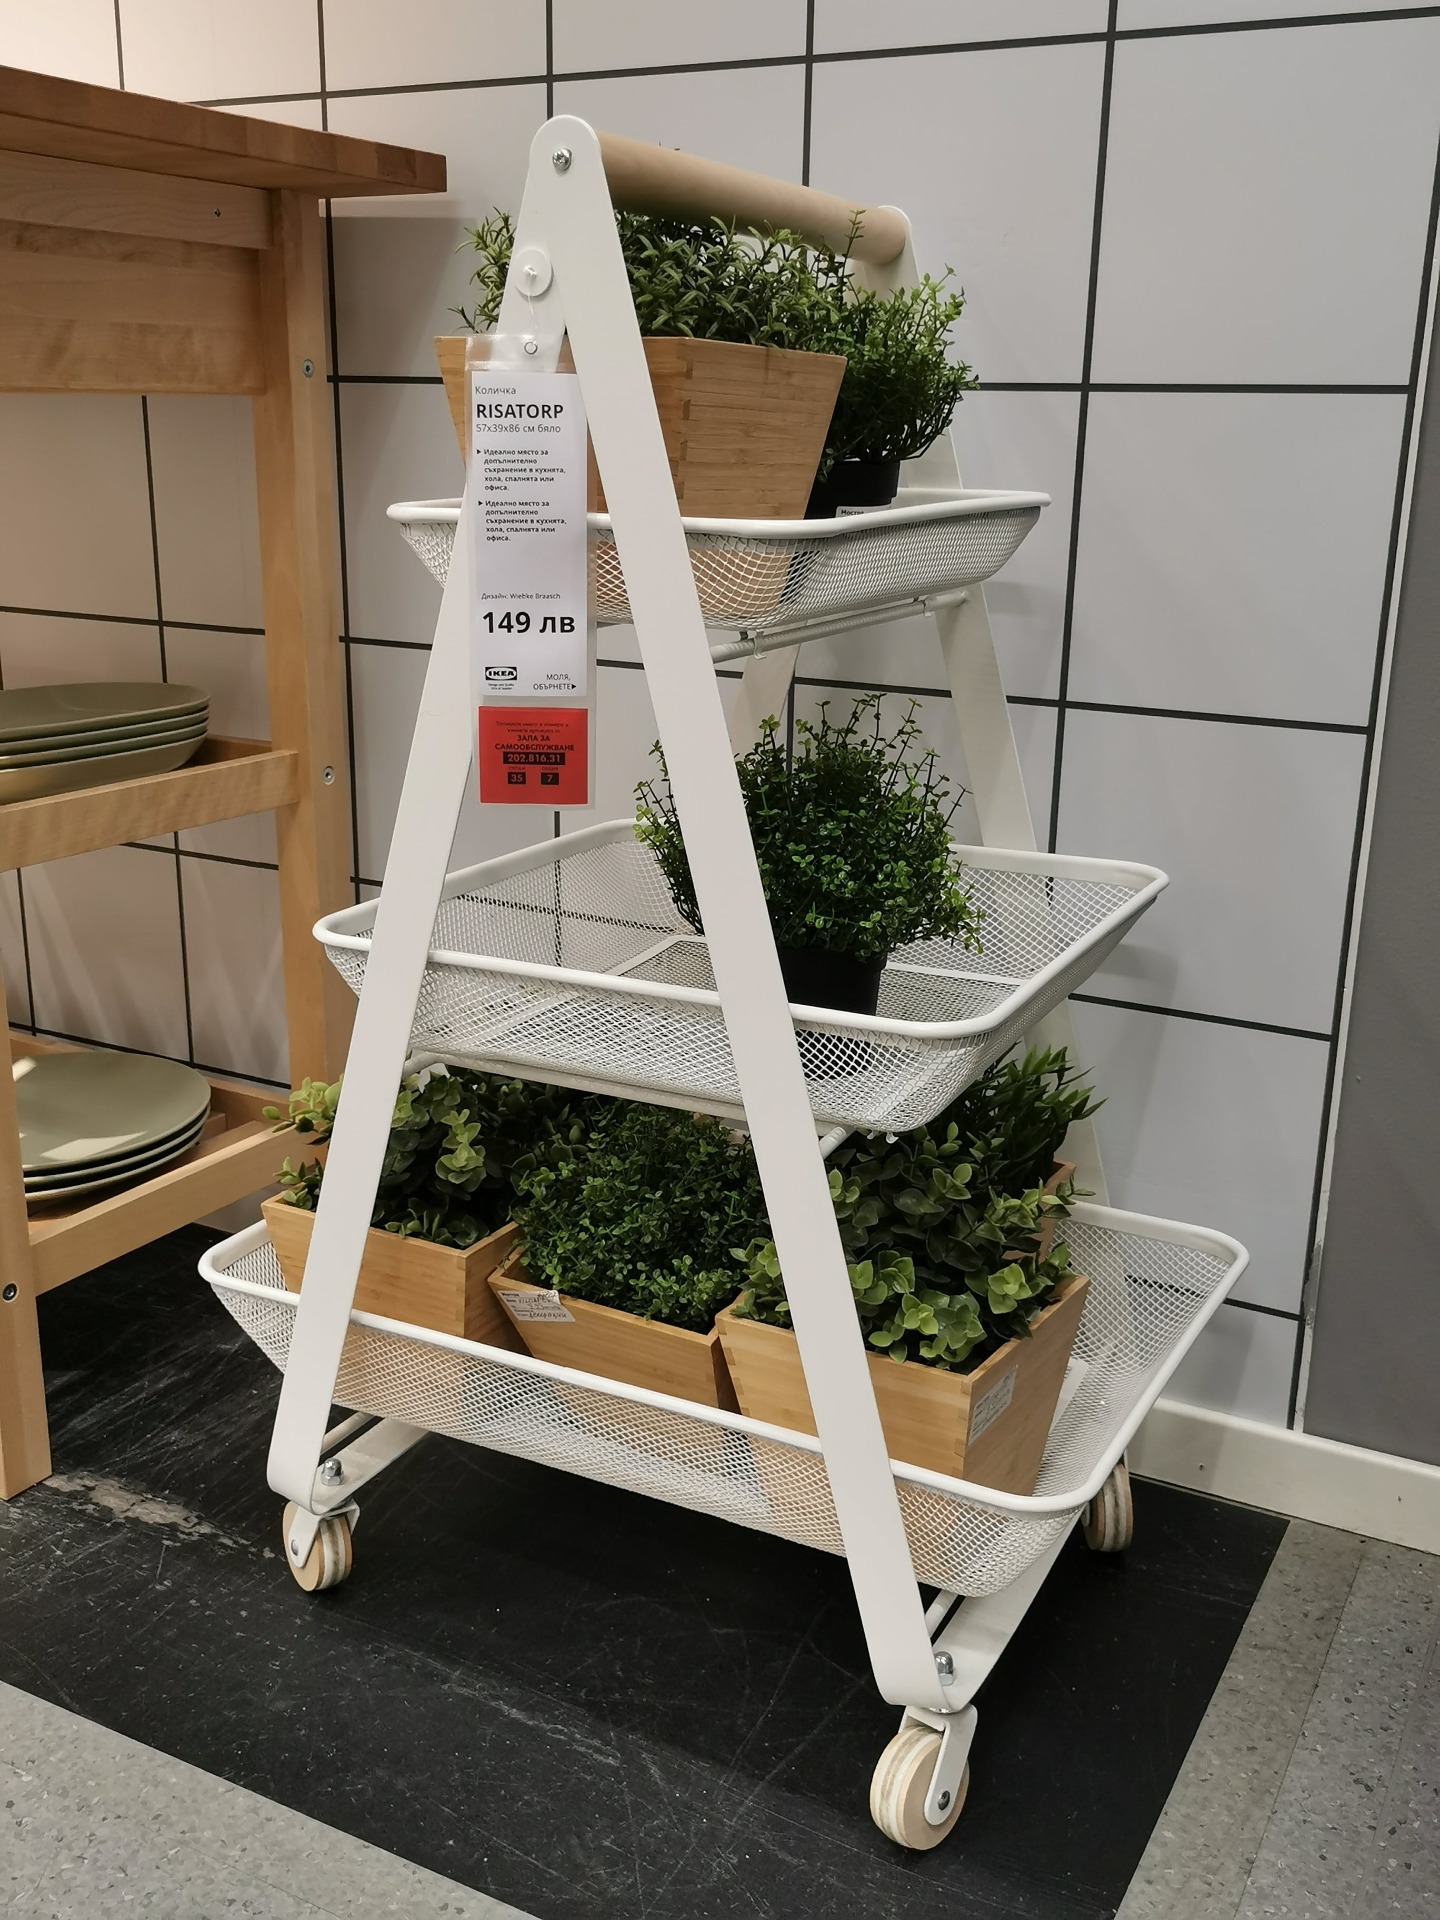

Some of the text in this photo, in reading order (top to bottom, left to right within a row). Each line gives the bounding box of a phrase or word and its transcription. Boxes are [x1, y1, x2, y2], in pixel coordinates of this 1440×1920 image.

[475, 386, 516, 395] Количка
[476, 404, 563, 418] RISATORP
[476, 424, 520, 433] 57x39x86
[537, 424, 561, 433] бяло
[483, 611, 575, 633] 149 лв
[533, 683, 571, 691] ОБЪРНЕТЕ
[495, 743, 574, 751] САМООБСЛУЖВАНЕ
[507, 754, 560, 763] 202.816.31
[511, 774, 523, 782] 35
